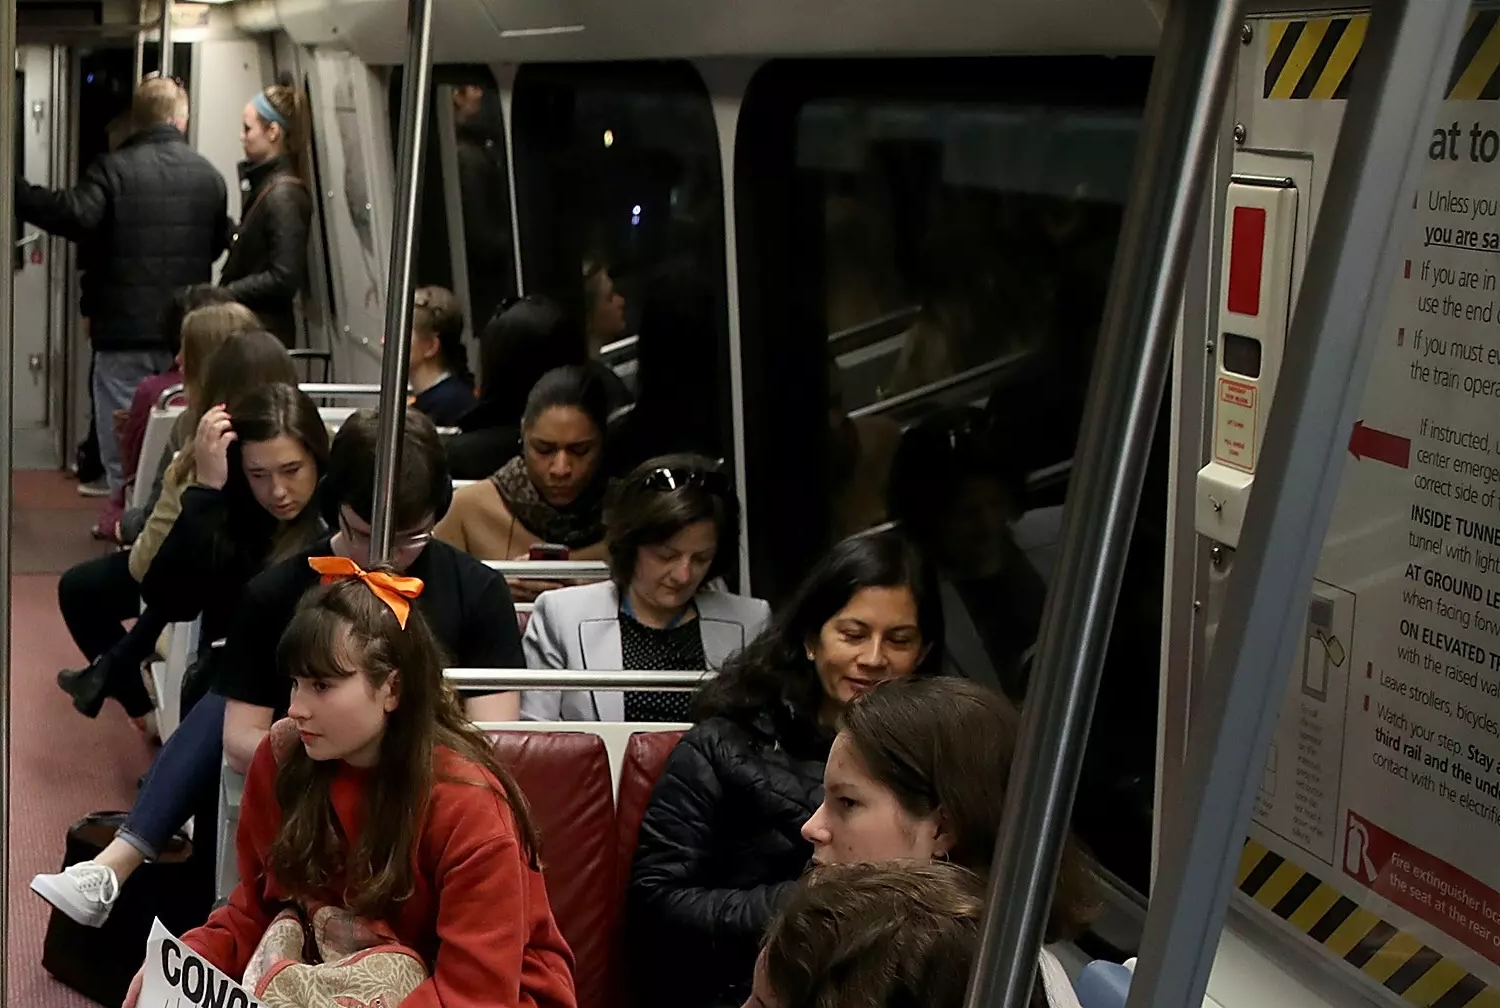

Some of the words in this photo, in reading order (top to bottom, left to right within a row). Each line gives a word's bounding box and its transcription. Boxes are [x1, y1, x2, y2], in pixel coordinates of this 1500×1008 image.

[1428, 121, 1462, 162] at
[1428, 190, 1470, 214] Unless
[1471, 197, 1498, 220] you
[1424, 226, 1452, 247] you
[1455, 228, 1478, 247] are
[1420, 260, 1431, 281] If
[1431, 267, 1456, 288] you
[1458, 270, 1479, 289] are
[1483, 269, 1496, 291] in
[1418, 295, 1439, 314] use
[1443, 295, 1462, 318] the
[1466, 301, 1493, 323] end
[1413, 329, 1423, 350] If
[1423, 336, 1447, 357] you
[1450, 341, 1484, 363] must
[1410, 360, 1430, 383] the
[1433, 366, 1460, 390] train
[1420, 418, 1429, 436] If
[1430, 421, 1491, 455] instructed,
[1417, 449, 1450, 469] center
[1453, 458, 1500, 485] emerge
[1414, 474, 1452, 498] correct
[1454, 483, 1479, 504] side
[1481, 490, 1496, 508] of
[1411, 504, 1452, 532] INSIDE
[1409, 530, 1443, 555] tunnel
[1446, 542, 1471, 564] with
[1404, 563, 1422, 581] AT
[1424, 569, 1483, 602] GROUND
[1403, 589, 1433, 613] when
[1436, 597, 1471, 629] facing
[1400, 619, 1419, 640] ON
[1422, 627, 1485, 665] ELEVATED
[1398, 645, 1420, 666] with
[1424, 653, 1442, 674] the
[1445, 664, 1478, 688] raised
[1380, 670, 1407, 696] Leave
[1409, 685, 1452, 718] strollers,
[1457, 701, 1500, 739] bicycles,
[1375, 727, 1401, 751] third
[1403, 744, 1422, 762] rail
[1424, 753, 1449, 774] and
[1451, 762, 1472, 785] the
[1377, 701, 1408, 731] Watch
[1410, 722, 1435, 743] your
[1438, 733, 1464, 757] step.
[1467, 744, 1494, 773] Stay
[1372, 751, 1409, 781] contact
[1411, 772, 1436, 793] with
[1439, 781, 1457, 803] the
[1391, 852, 1411, 874] Fire
[1413, 864, 1482, 912] extinguisher
[1389, 872, 1408, 893] the
[1409, 885, 1433, 906] seat
[1434, 899, 1446, 915] at
[1448, 905, 1466, 927] the
[1468, 919, 1492, 940] rear
